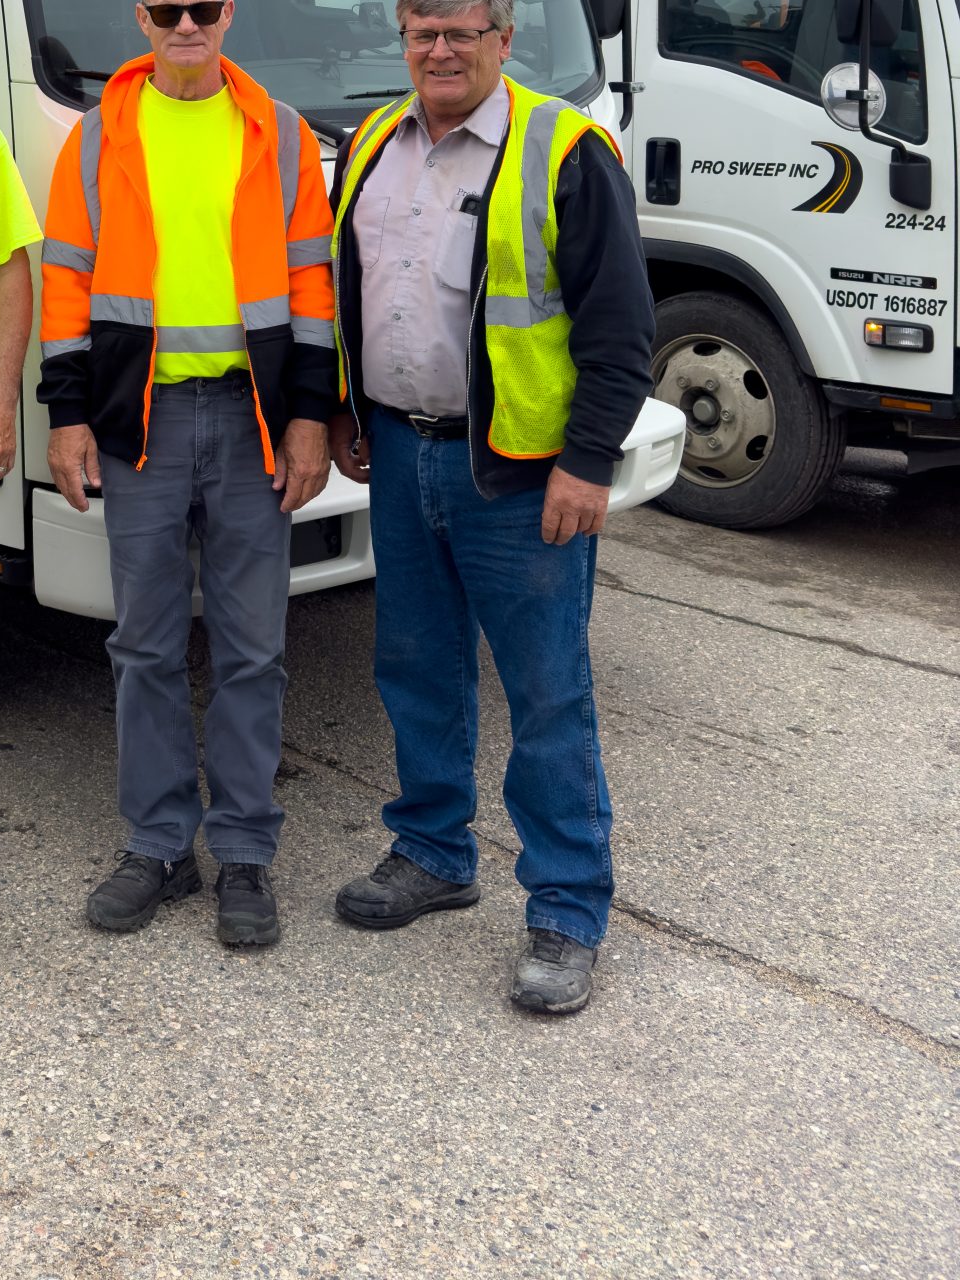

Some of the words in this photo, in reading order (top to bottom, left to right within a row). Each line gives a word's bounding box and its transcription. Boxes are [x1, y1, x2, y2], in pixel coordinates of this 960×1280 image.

[691, 160, 725, 175] PRO
[727, 161, 787, 177] SWEEP
[788, 163, 819, 179] INC
[884, 213, 946, 231] 224-24
[838, 271, 864, 280] ISUZU
[872, 273, 922, 287] NRR
[826, 289, 878, 310] USDOT
[884, 295, 948, 317] 1616887
